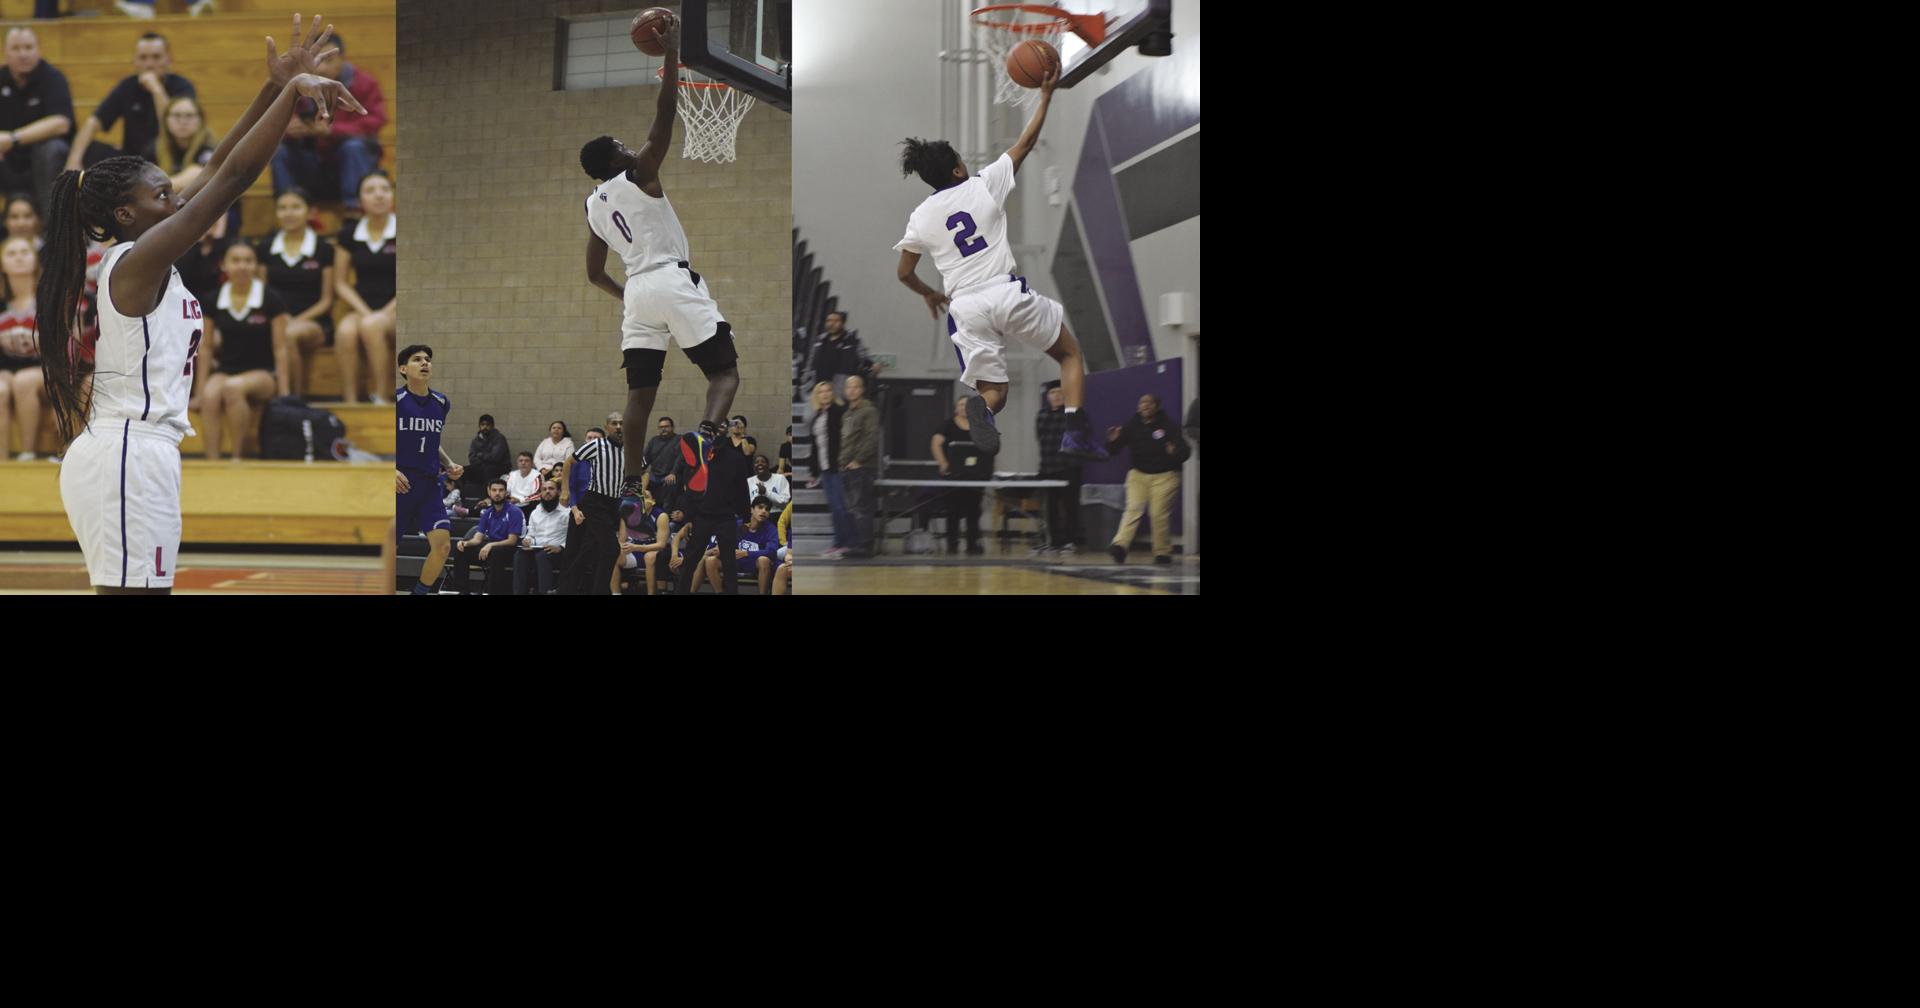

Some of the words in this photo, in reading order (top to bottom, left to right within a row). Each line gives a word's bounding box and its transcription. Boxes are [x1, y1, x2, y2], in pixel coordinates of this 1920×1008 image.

[612, 210, 632, 244] 0
[945, 211, 989, 258] 2
[399, 417, 443, 433] LIONS
[417, 436, 426, 453] 1
[155, 546, 166, 577] L
